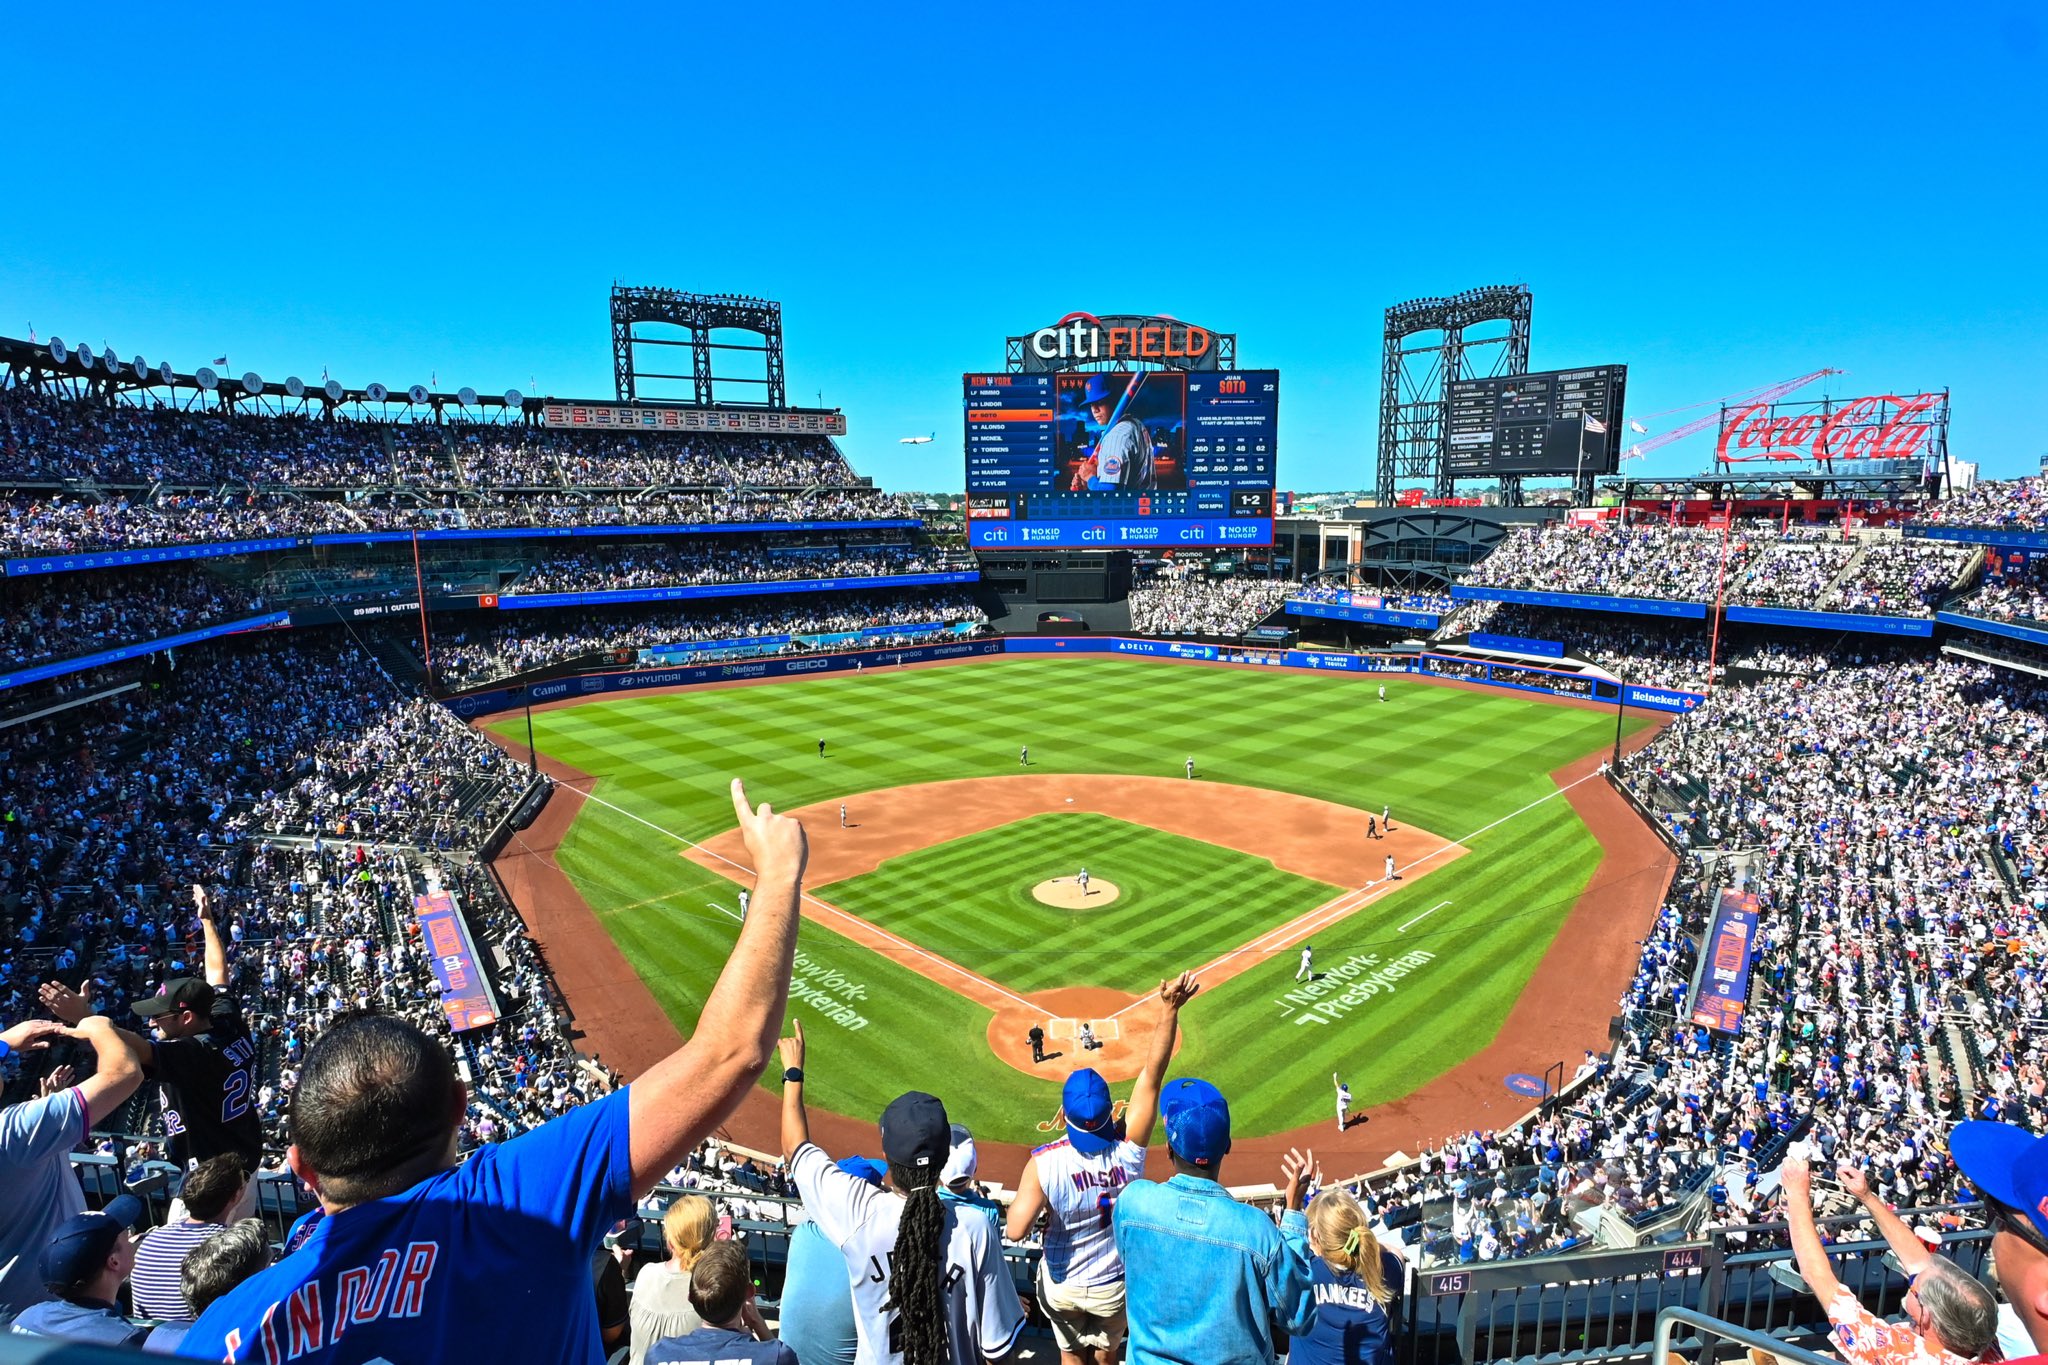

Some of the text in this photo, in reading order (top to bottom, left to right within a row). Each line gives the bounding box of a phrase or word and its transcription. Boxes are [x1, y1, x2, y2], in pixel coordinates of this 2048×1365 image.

[1033, 320, 1209, 358] citi FIELD
[971, 377, 1012, 386] NEW YORK
[1572, 371, 1595, 380] SEQUENCE
[1219, 380, 1246, 394] SOTO
[1241, 495, 1260, 505] 1-2
[984, 527, 1007, 541] citi
[1082, 527, 1105, 541] citi
[1180, 526, 1203, 540] citi
[354, 602, 420, 616] 89 MPH CUTTER
[934, 645, 968, 655] smartwater
[984, 643, 998, 653] citi
[1127, 643, 1154, 651] DELTA
[732, 664, 766, 674] National
[786, 659, 828, 671] GEICO
[637, 673, 681, 684] HYUNDAI
[1435, 672, 1466, 682] CADILLAC
[532, 683, 567, 697] Canon
[1554, 689, 1593, 700] CADILLAC
[1632, 691, 1681, 706] Heineken
[1284, 974, 1344, 1005] New
[1313, 950, 1436, 1019] Presbyterian
[788, 976, 869, 1031] byterian
[1072, 1166, 1128, 1192] WILSON
[1672, 1252, 1693, 1266] 414
[1439, 1276, 1462, 1291] 415
